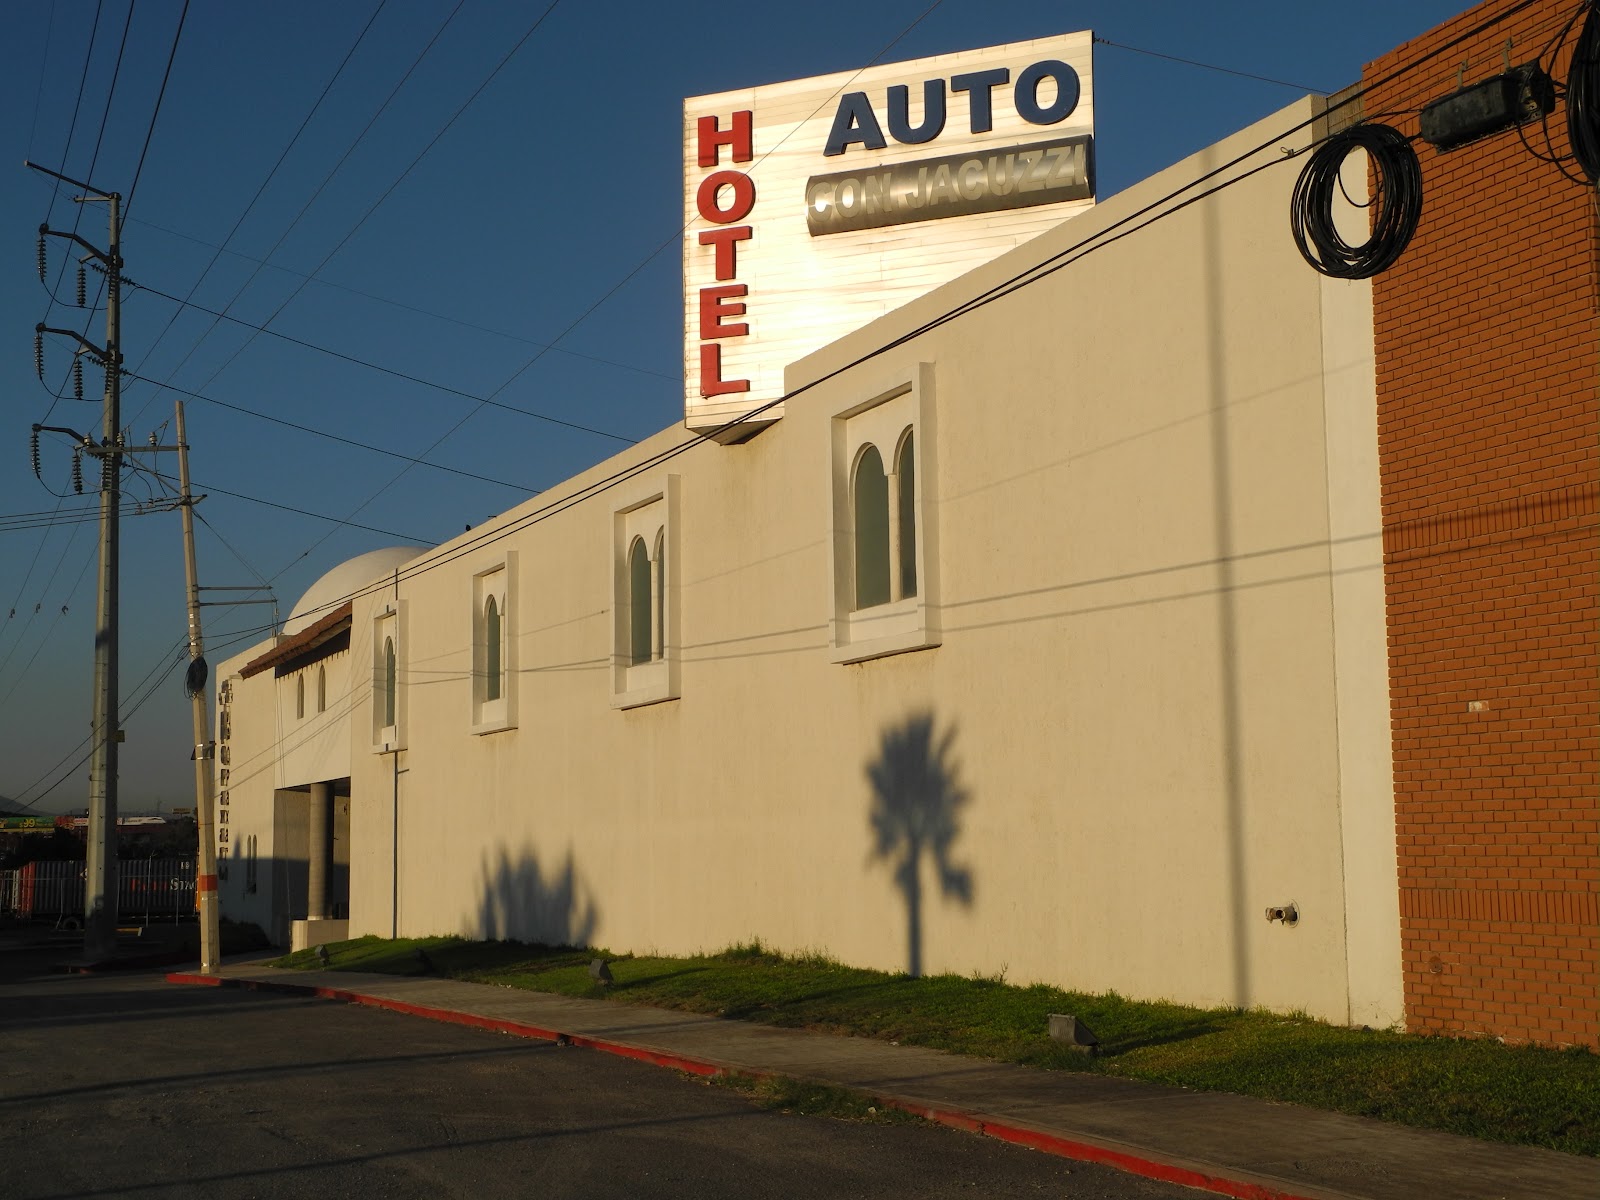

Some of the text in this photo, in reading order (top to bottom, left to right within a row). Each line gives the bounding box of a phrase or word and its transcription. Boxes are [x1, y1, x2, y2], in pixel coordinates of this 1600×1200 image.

[823, 60, 1081, 157] AUTO
[807, 144, 1086, 222] CON JACUZZI
[697, 110, 756, 399] HOTEL
